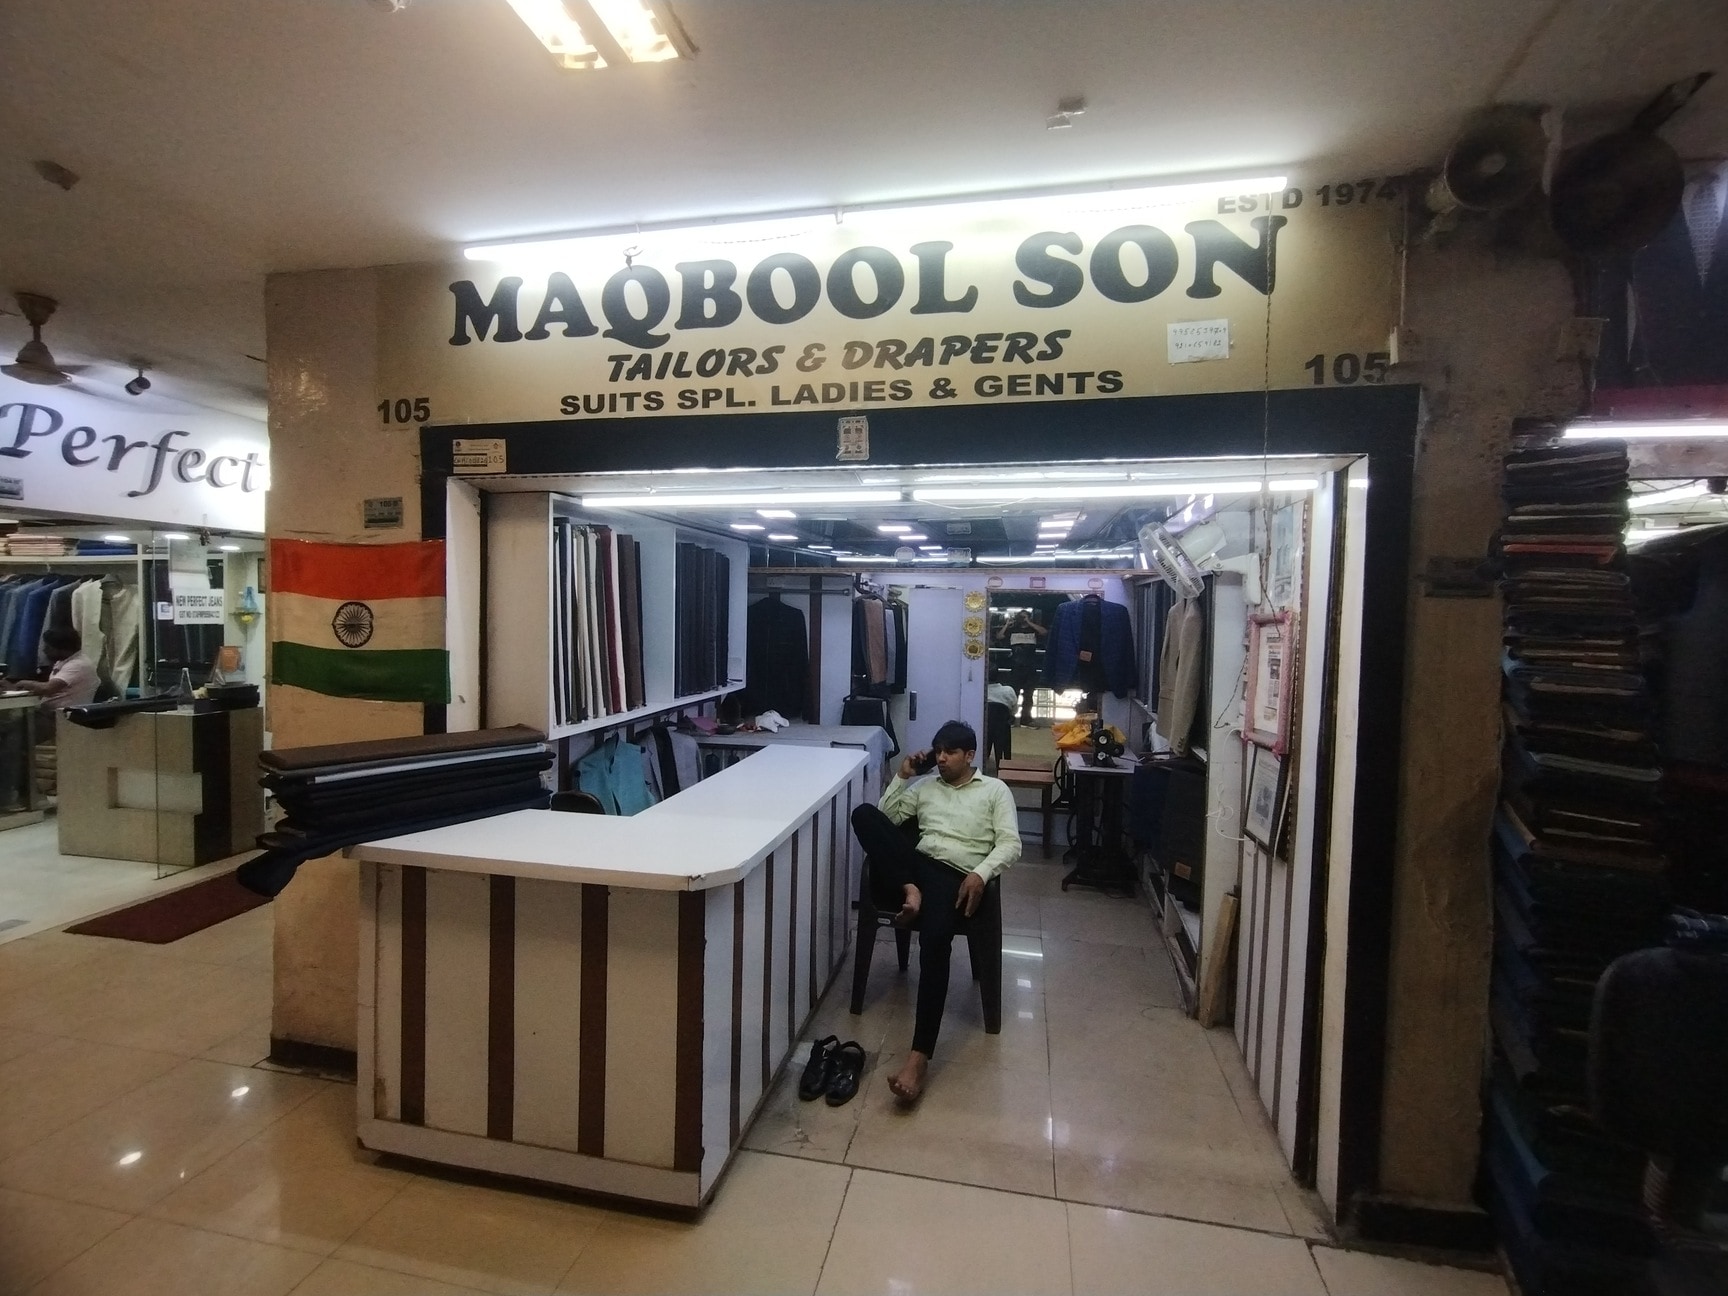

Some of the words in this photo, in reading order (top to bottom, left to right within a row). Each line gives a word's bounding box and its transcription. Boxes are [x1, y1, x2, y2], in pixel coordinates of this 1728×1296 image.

[1316, 180, 1397, 207] 1974
[448, 241, 979, 349] MAQBOOL
[1013, 215, 1287, 308] SON
[607, 344, 786, 383] TAILORS
[796, 343, 826, 373] &
[841, 329, 1072, 372] DRAPERS
[1304, 352, 1391, 386] 105
[377, 397, 431, 424] 105
[560, 390, 665, 416] SUITS
[677, 386, 757, 411] SPL.
[771, 378, 912, 406] LADIES
[929, 377, 958, 400] &
[974, 370, 1125, 397] GENTS
[0, 402, 266, 498] Perfect
[187, 595, 207, 606] PERFECT
[208, 596, 223, 607] JEANS
